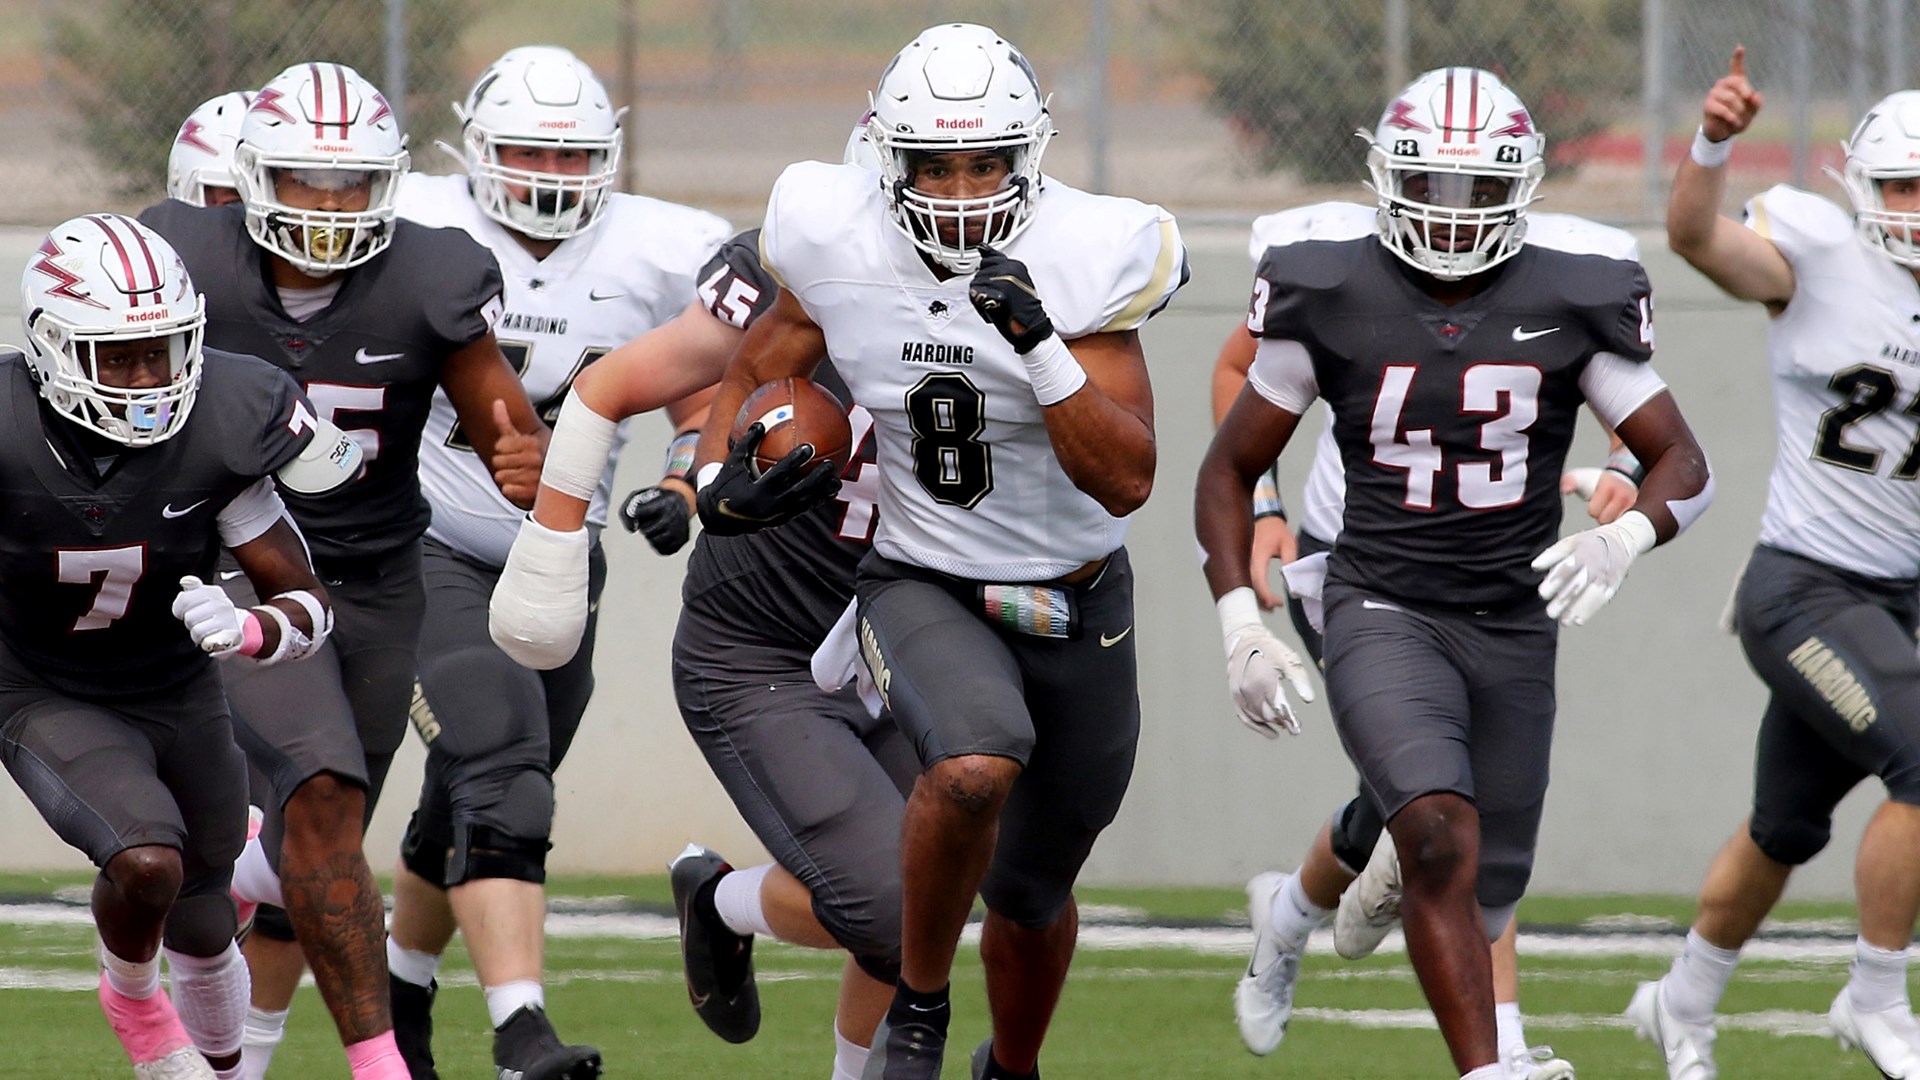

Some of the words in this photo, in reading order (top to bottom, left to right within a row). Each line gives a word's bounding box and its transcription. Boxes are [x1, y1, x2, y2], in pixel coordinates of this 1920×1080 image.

[936, 117, 983, 129] Riddell
[126, 309, 169, 322] Riddell
[503, 312, 568, 335] HARDING
[697, 263, 760, 330] 45
[901, 342, 974, 364] HARDING
[904, 371, 994, 511] 8
[1368, 361, 1544, 512] 43
[53, 540, 148, 634] 7
[1786, 635, 1877, 734] HARDING
